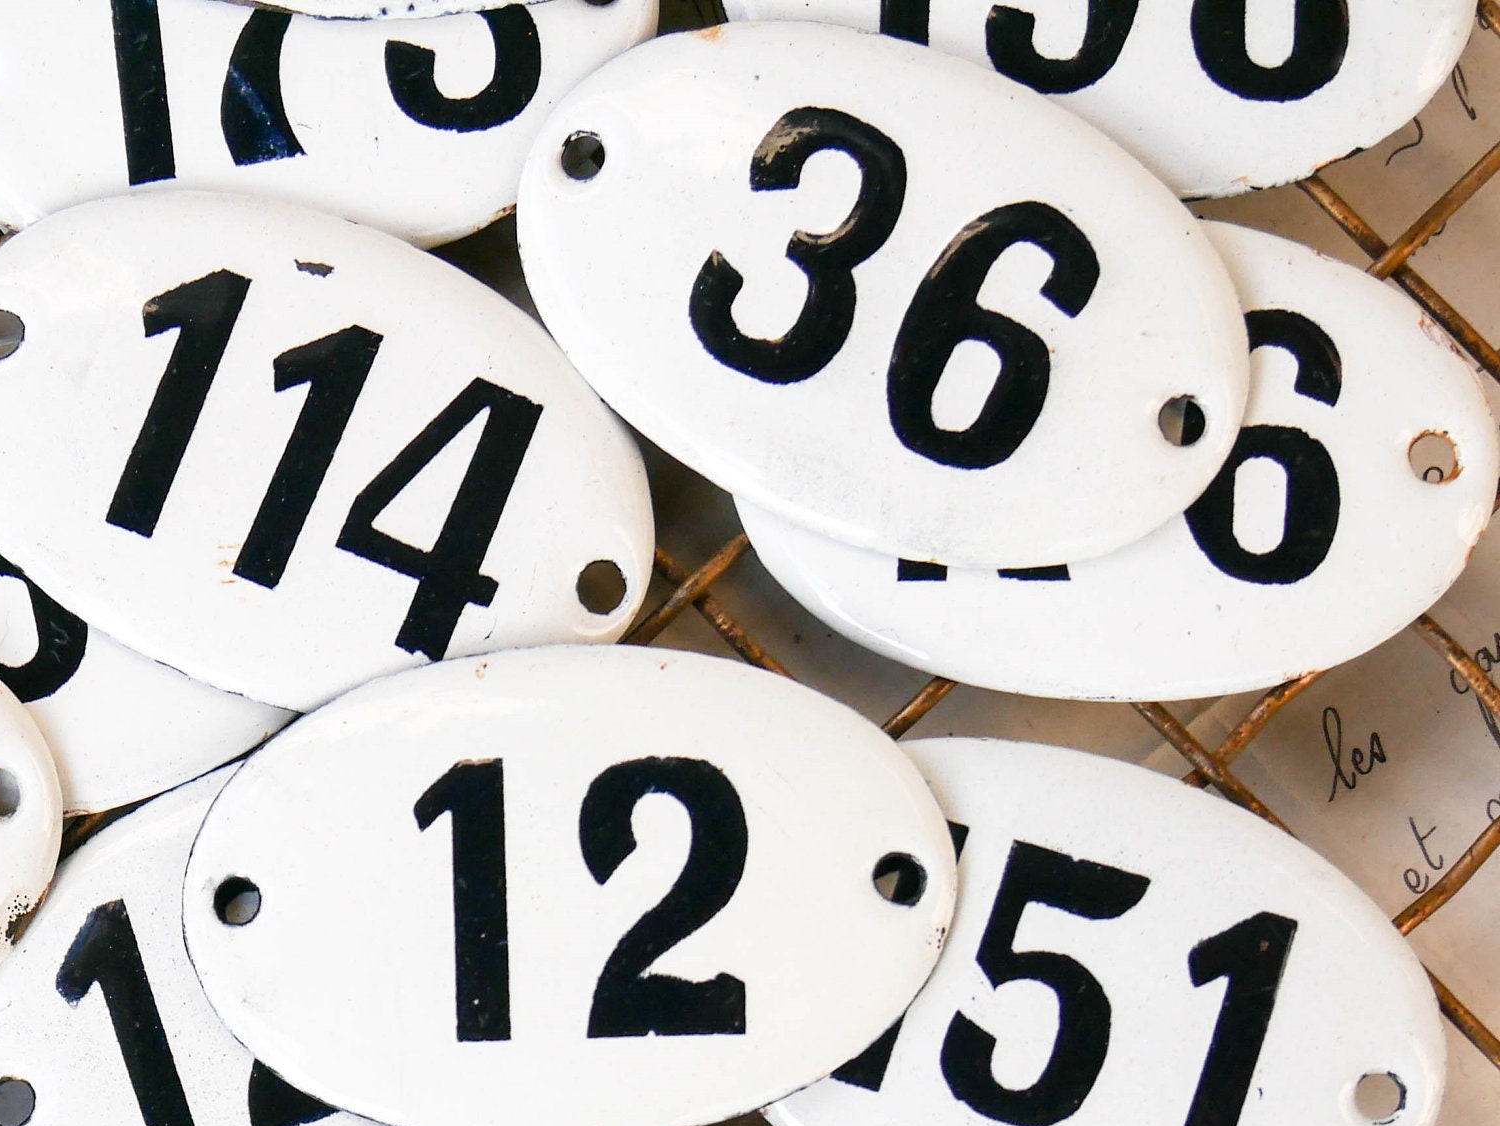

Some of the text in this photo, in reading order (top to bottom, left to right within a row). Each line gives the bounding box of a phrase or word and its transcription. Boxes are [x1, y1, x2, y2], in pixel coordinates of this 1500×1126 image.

[687, 105, 1100, 470] 36
[106, 268, 544, 662] 114
[1322, 706, 1387, 802] les
[1403, 816, 1444, 894] et
[414, 757, 748, 1043] 12
